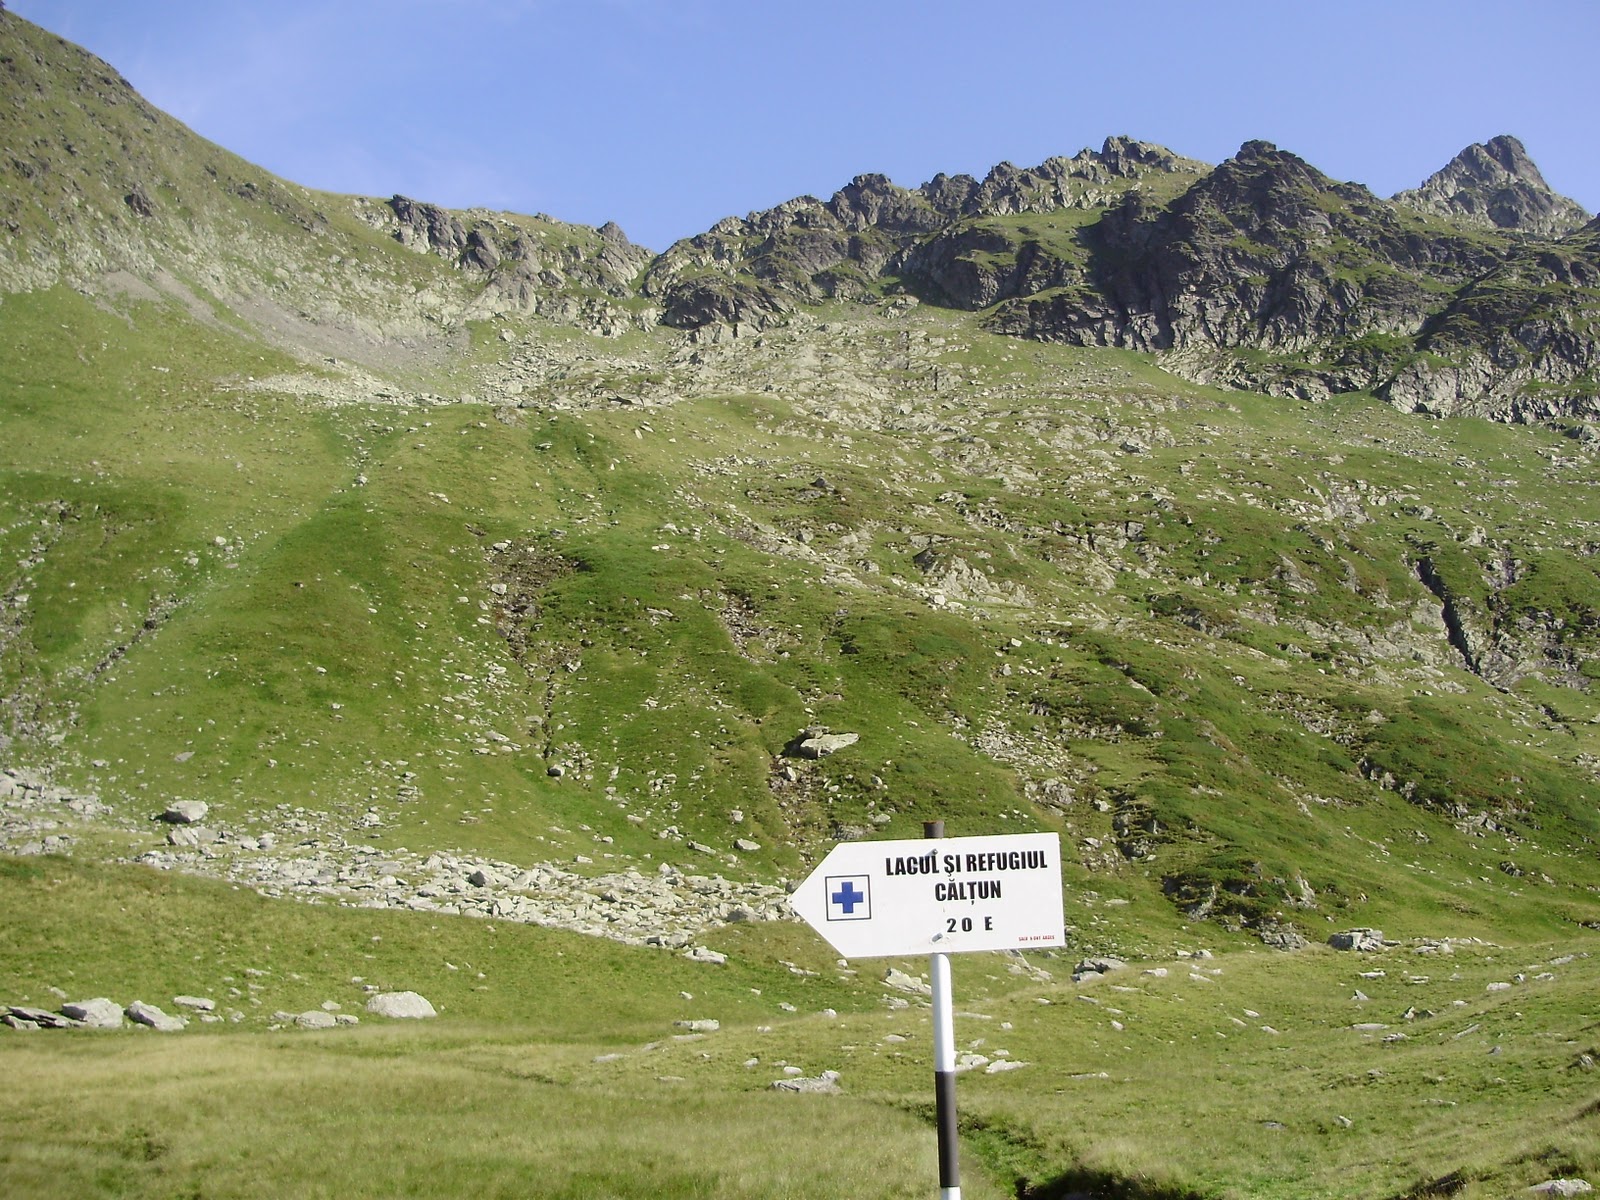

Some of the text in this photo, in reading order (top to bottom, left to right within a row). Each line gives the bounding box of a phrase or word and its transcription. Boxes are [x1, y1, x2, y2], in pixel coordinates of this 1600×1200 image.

[886, 855, 940, 876] LACUL
[966, 850, 1048, 872] REFUGIUL
[984, 916, 993, 931] E
